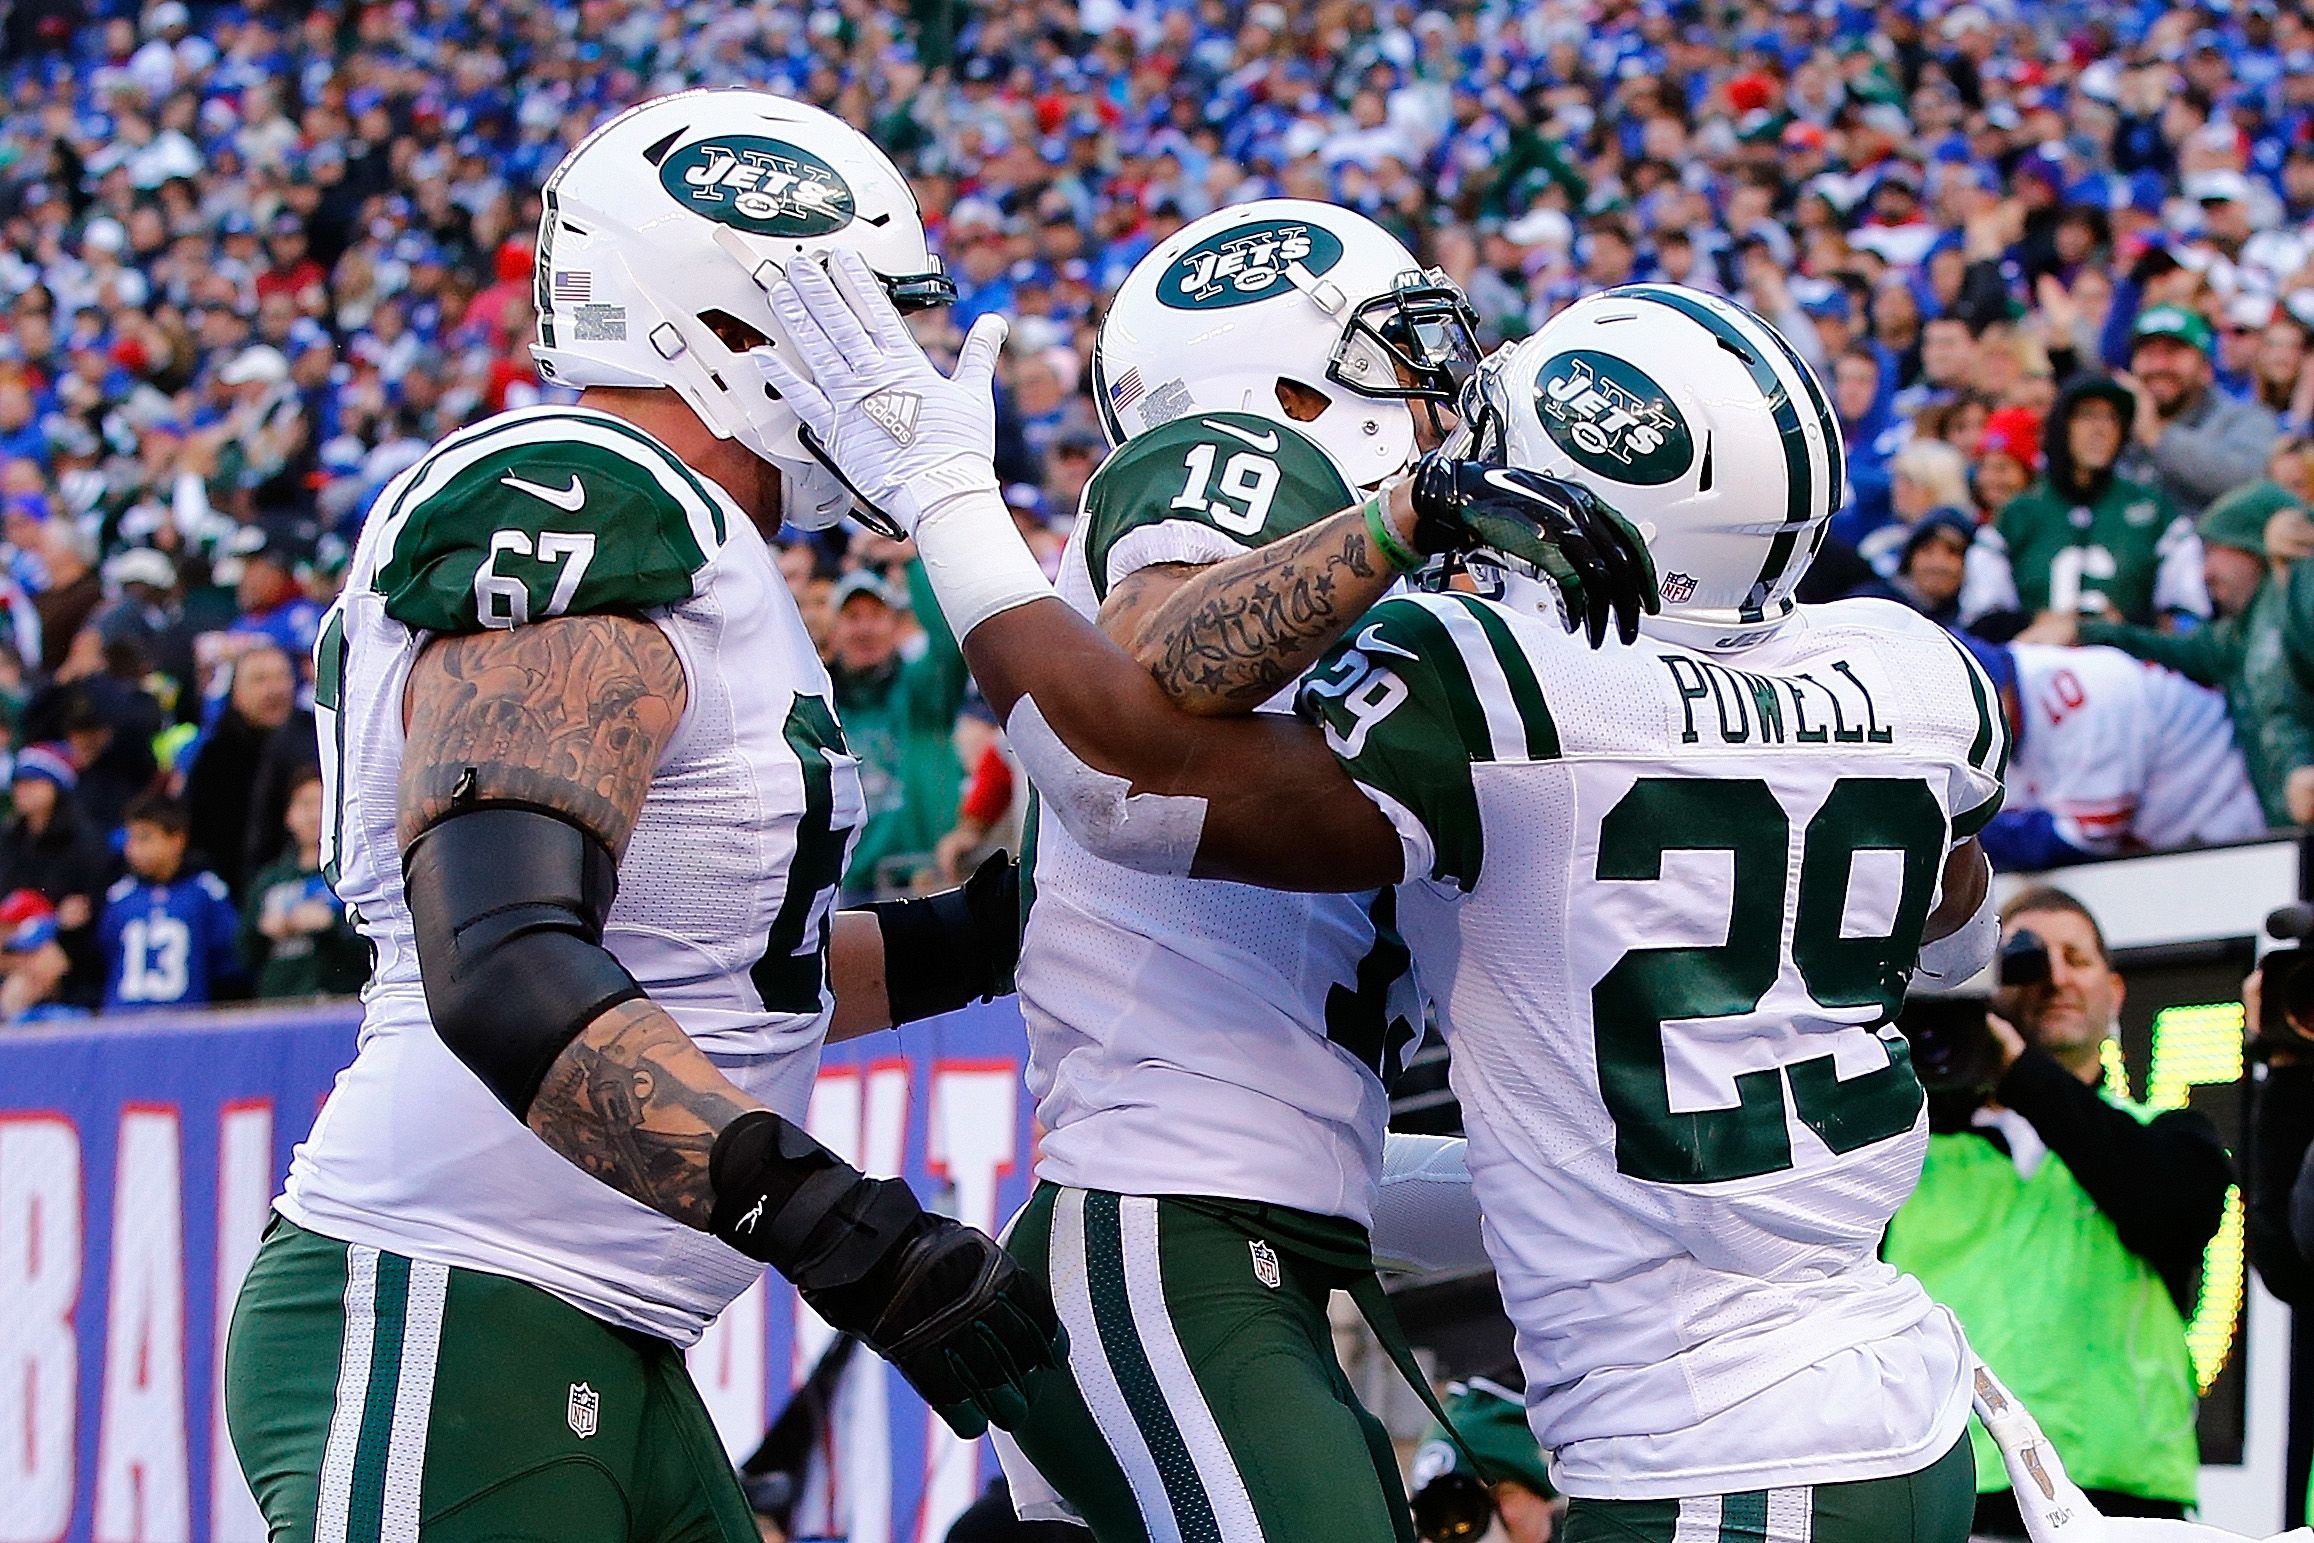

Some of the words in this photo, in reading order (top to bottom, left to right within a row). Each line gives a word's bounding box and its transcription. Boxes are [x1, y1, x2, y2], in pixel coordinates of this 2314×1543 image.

[684, 156, 833, 207] JETS
[1179, 236, 1312, 293] JETS
[1397, 271, 1421, 289] NY
[863, 397, 912, 443] adidas
[1547, 374, 1667, 455] JETS
[1170, 444, 1281, 536] 19
[474, 529, 596, 629] 67
[1662, 583, 1691, 601] NFL
[1714, 626, 1781, 648] JET
[1300, 649, 1409, 760] 29
[1657, 655, 1893, 744] POWELL
[117, 917, 191, 1002] 13
[1590, 777, 1947, 1184] 29
[572, 1404, 593, 1429] NFL
